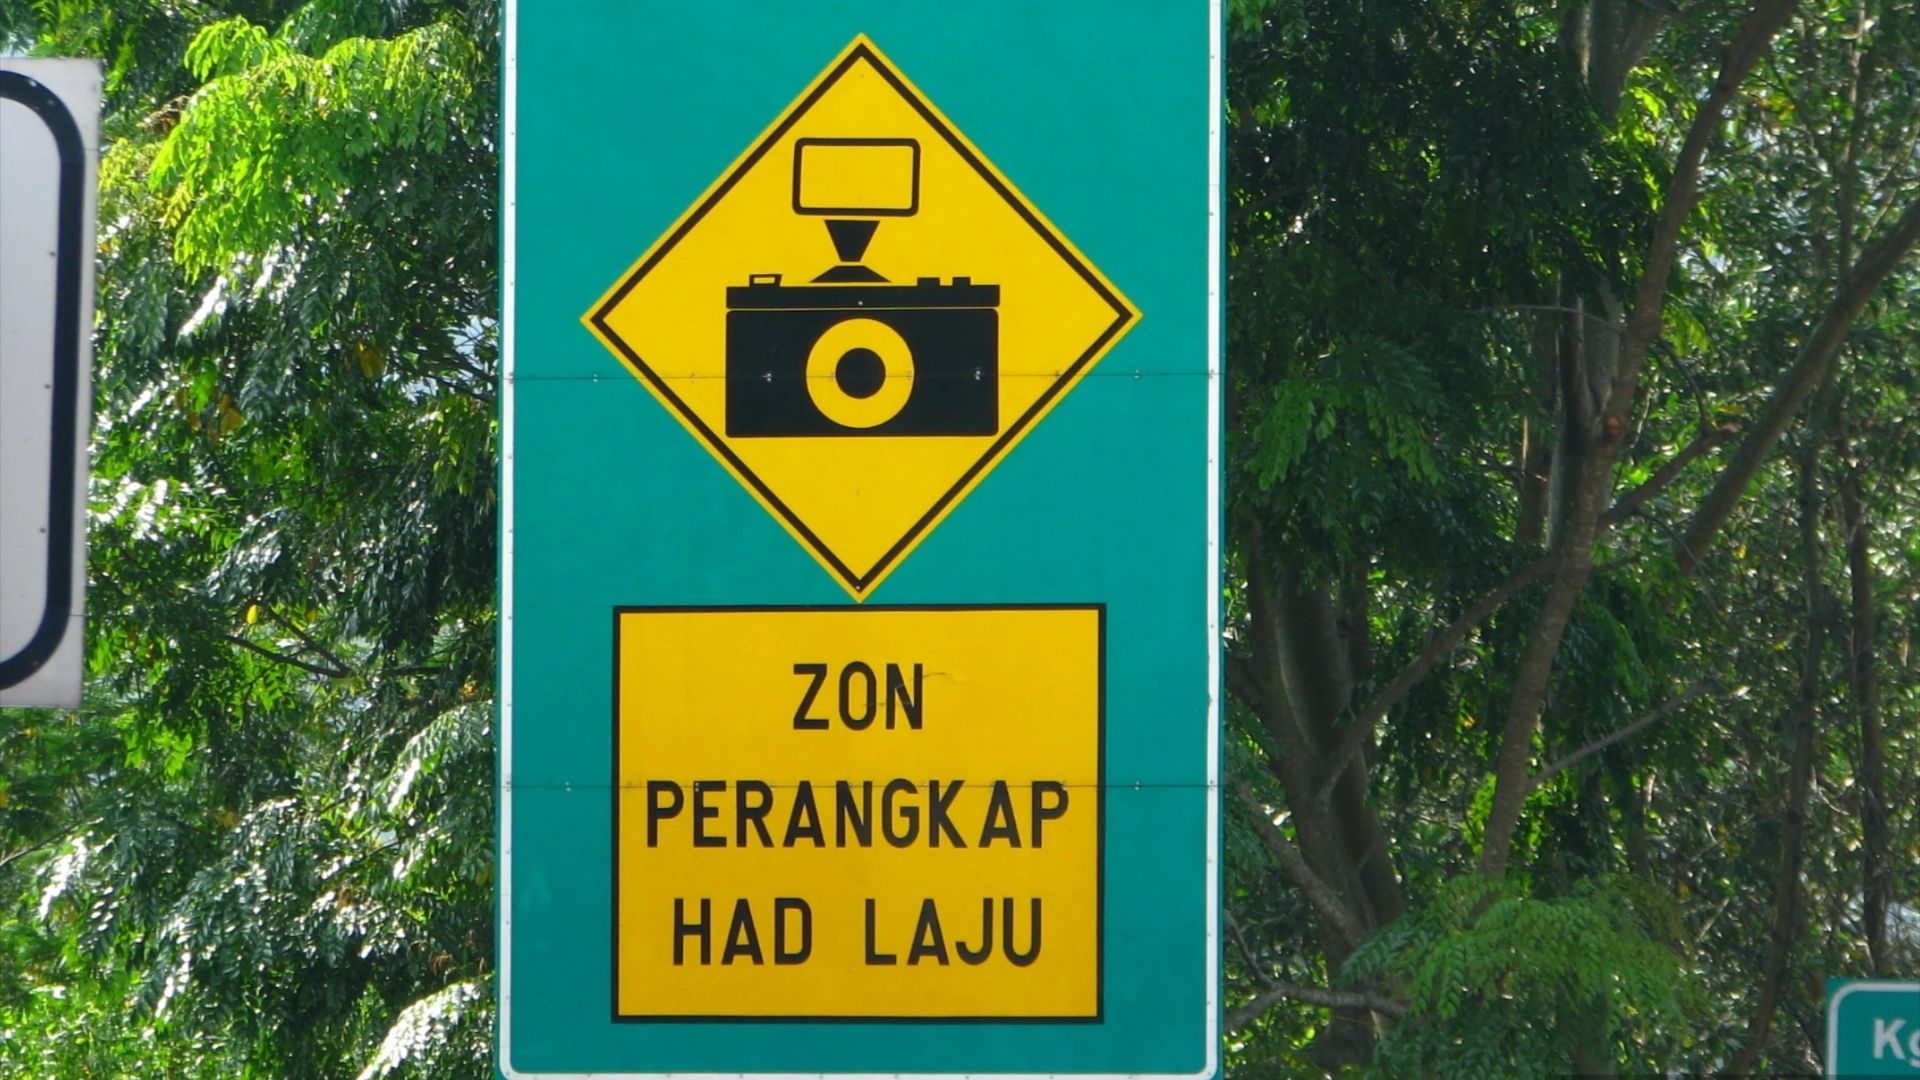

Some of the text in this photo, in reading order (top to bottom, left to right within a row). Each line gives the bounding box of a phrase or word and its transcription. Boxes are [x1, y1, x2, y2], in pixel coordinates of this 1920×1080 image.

[793, 661, 923, 731] ZON
[647, 778, 1069, 848] PERANGKAP
[673, 897, 1042, 967] HAD LAJU
